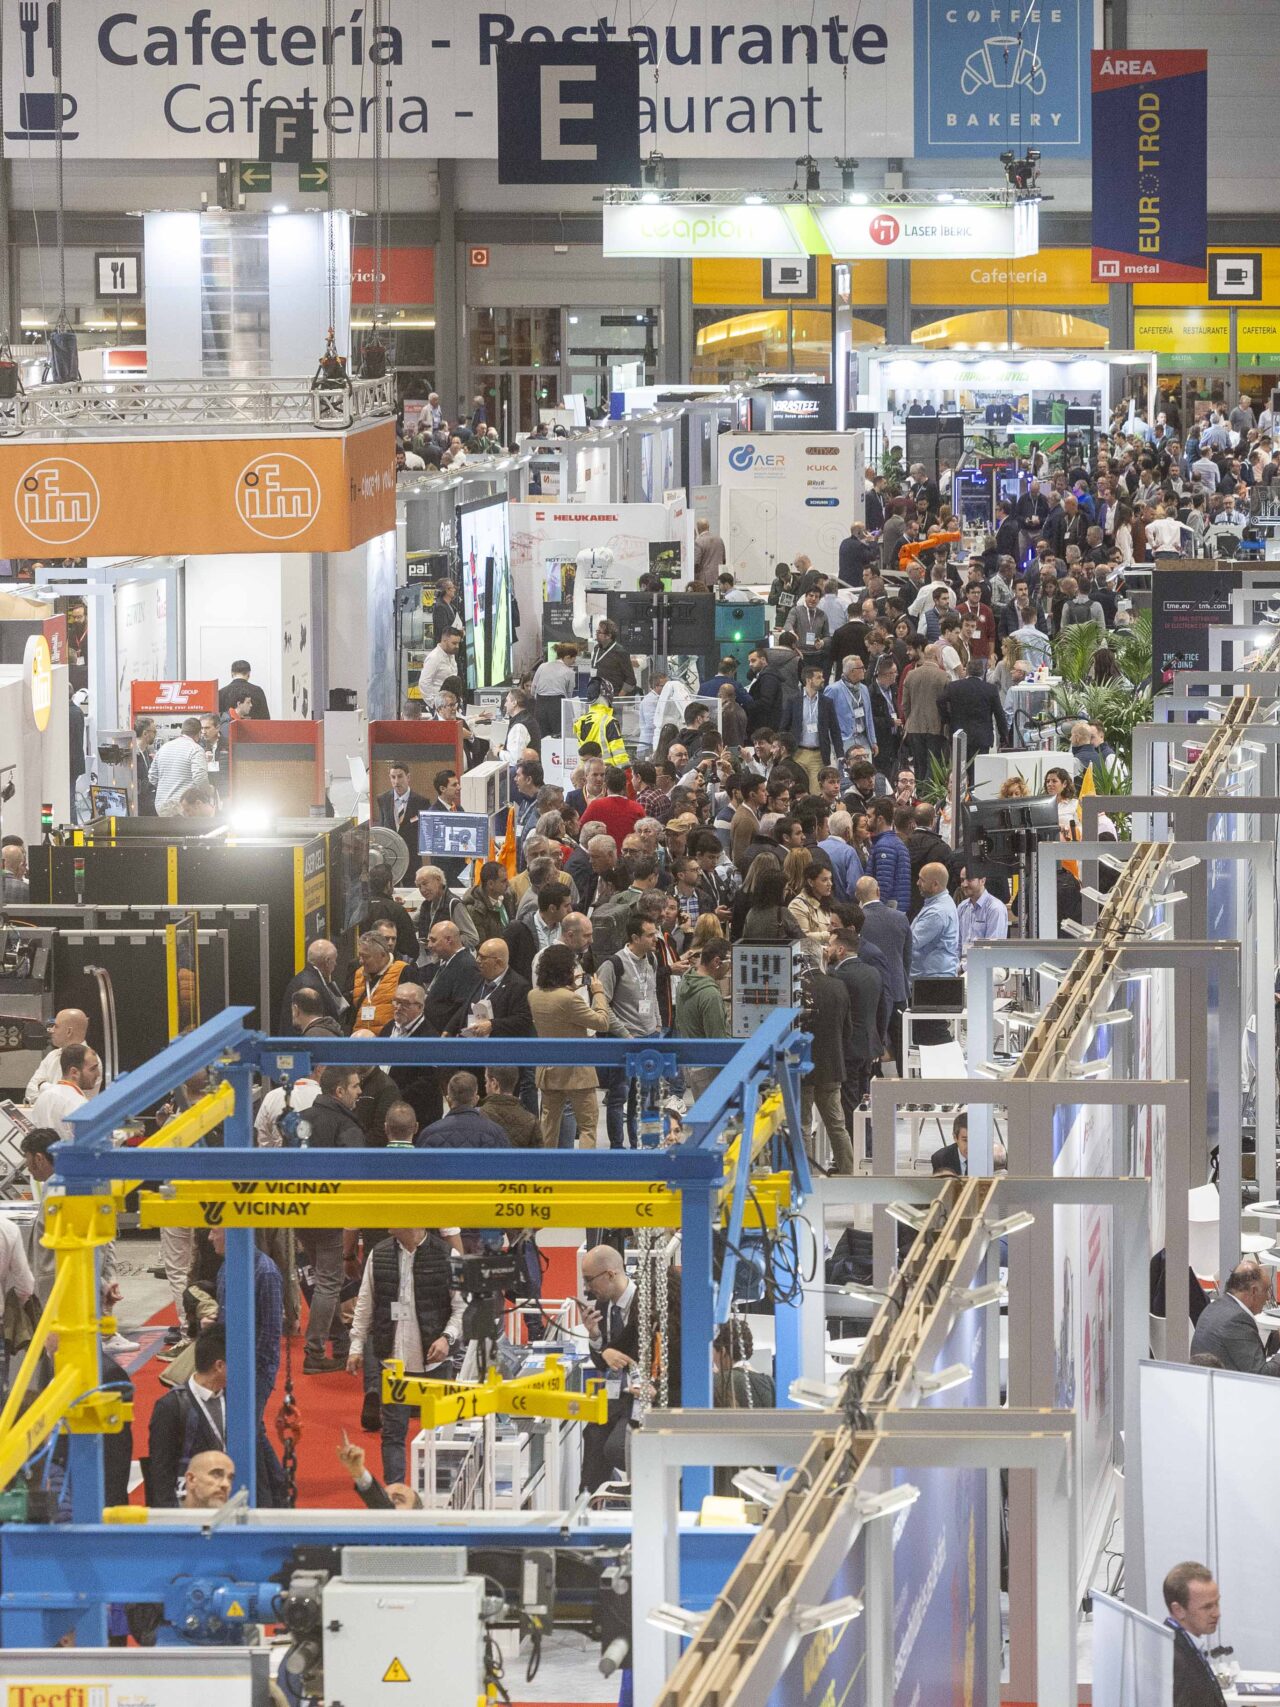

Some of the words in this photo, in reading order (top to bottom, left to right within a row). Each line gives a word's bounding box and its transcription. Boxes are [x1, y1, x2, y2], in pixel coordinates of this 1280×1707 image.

[98, 9, 403, 66] Cafetería
[1100, 57, 1156, 75] ÁREA
[541, 65, 597, 160] E
[639, 87, 822, 134] aurant
[947, 114, 1061, 126] BAKERY
[275, 117, 297, 154] F
[351, 269, 386, 283] vicio
[1125, 263, 1159, 274] metal
[970, 269, 1047, 284] Cafetería
[1139, 326, 1173, 335] CAFETERÍA
[1183, 326, 1228, 335] RESTAURANTE
[1242, 326, 1277, 335] CAFETERÍA
[408, 562, 428, 576] pai
[265, 1182, 341, 1194] VICINAY
[498, 1184, 527, 1194] 250
[534, 1184, 552, 1194] kg
[233, 1202, 310, 1215] VICINAY
[495, 1204, 524, 1216] 250
[531, 1204, 551, 1220] kg
[456, 1396, 466, 1420] 2
[472, 1394, 478, 1416] t
